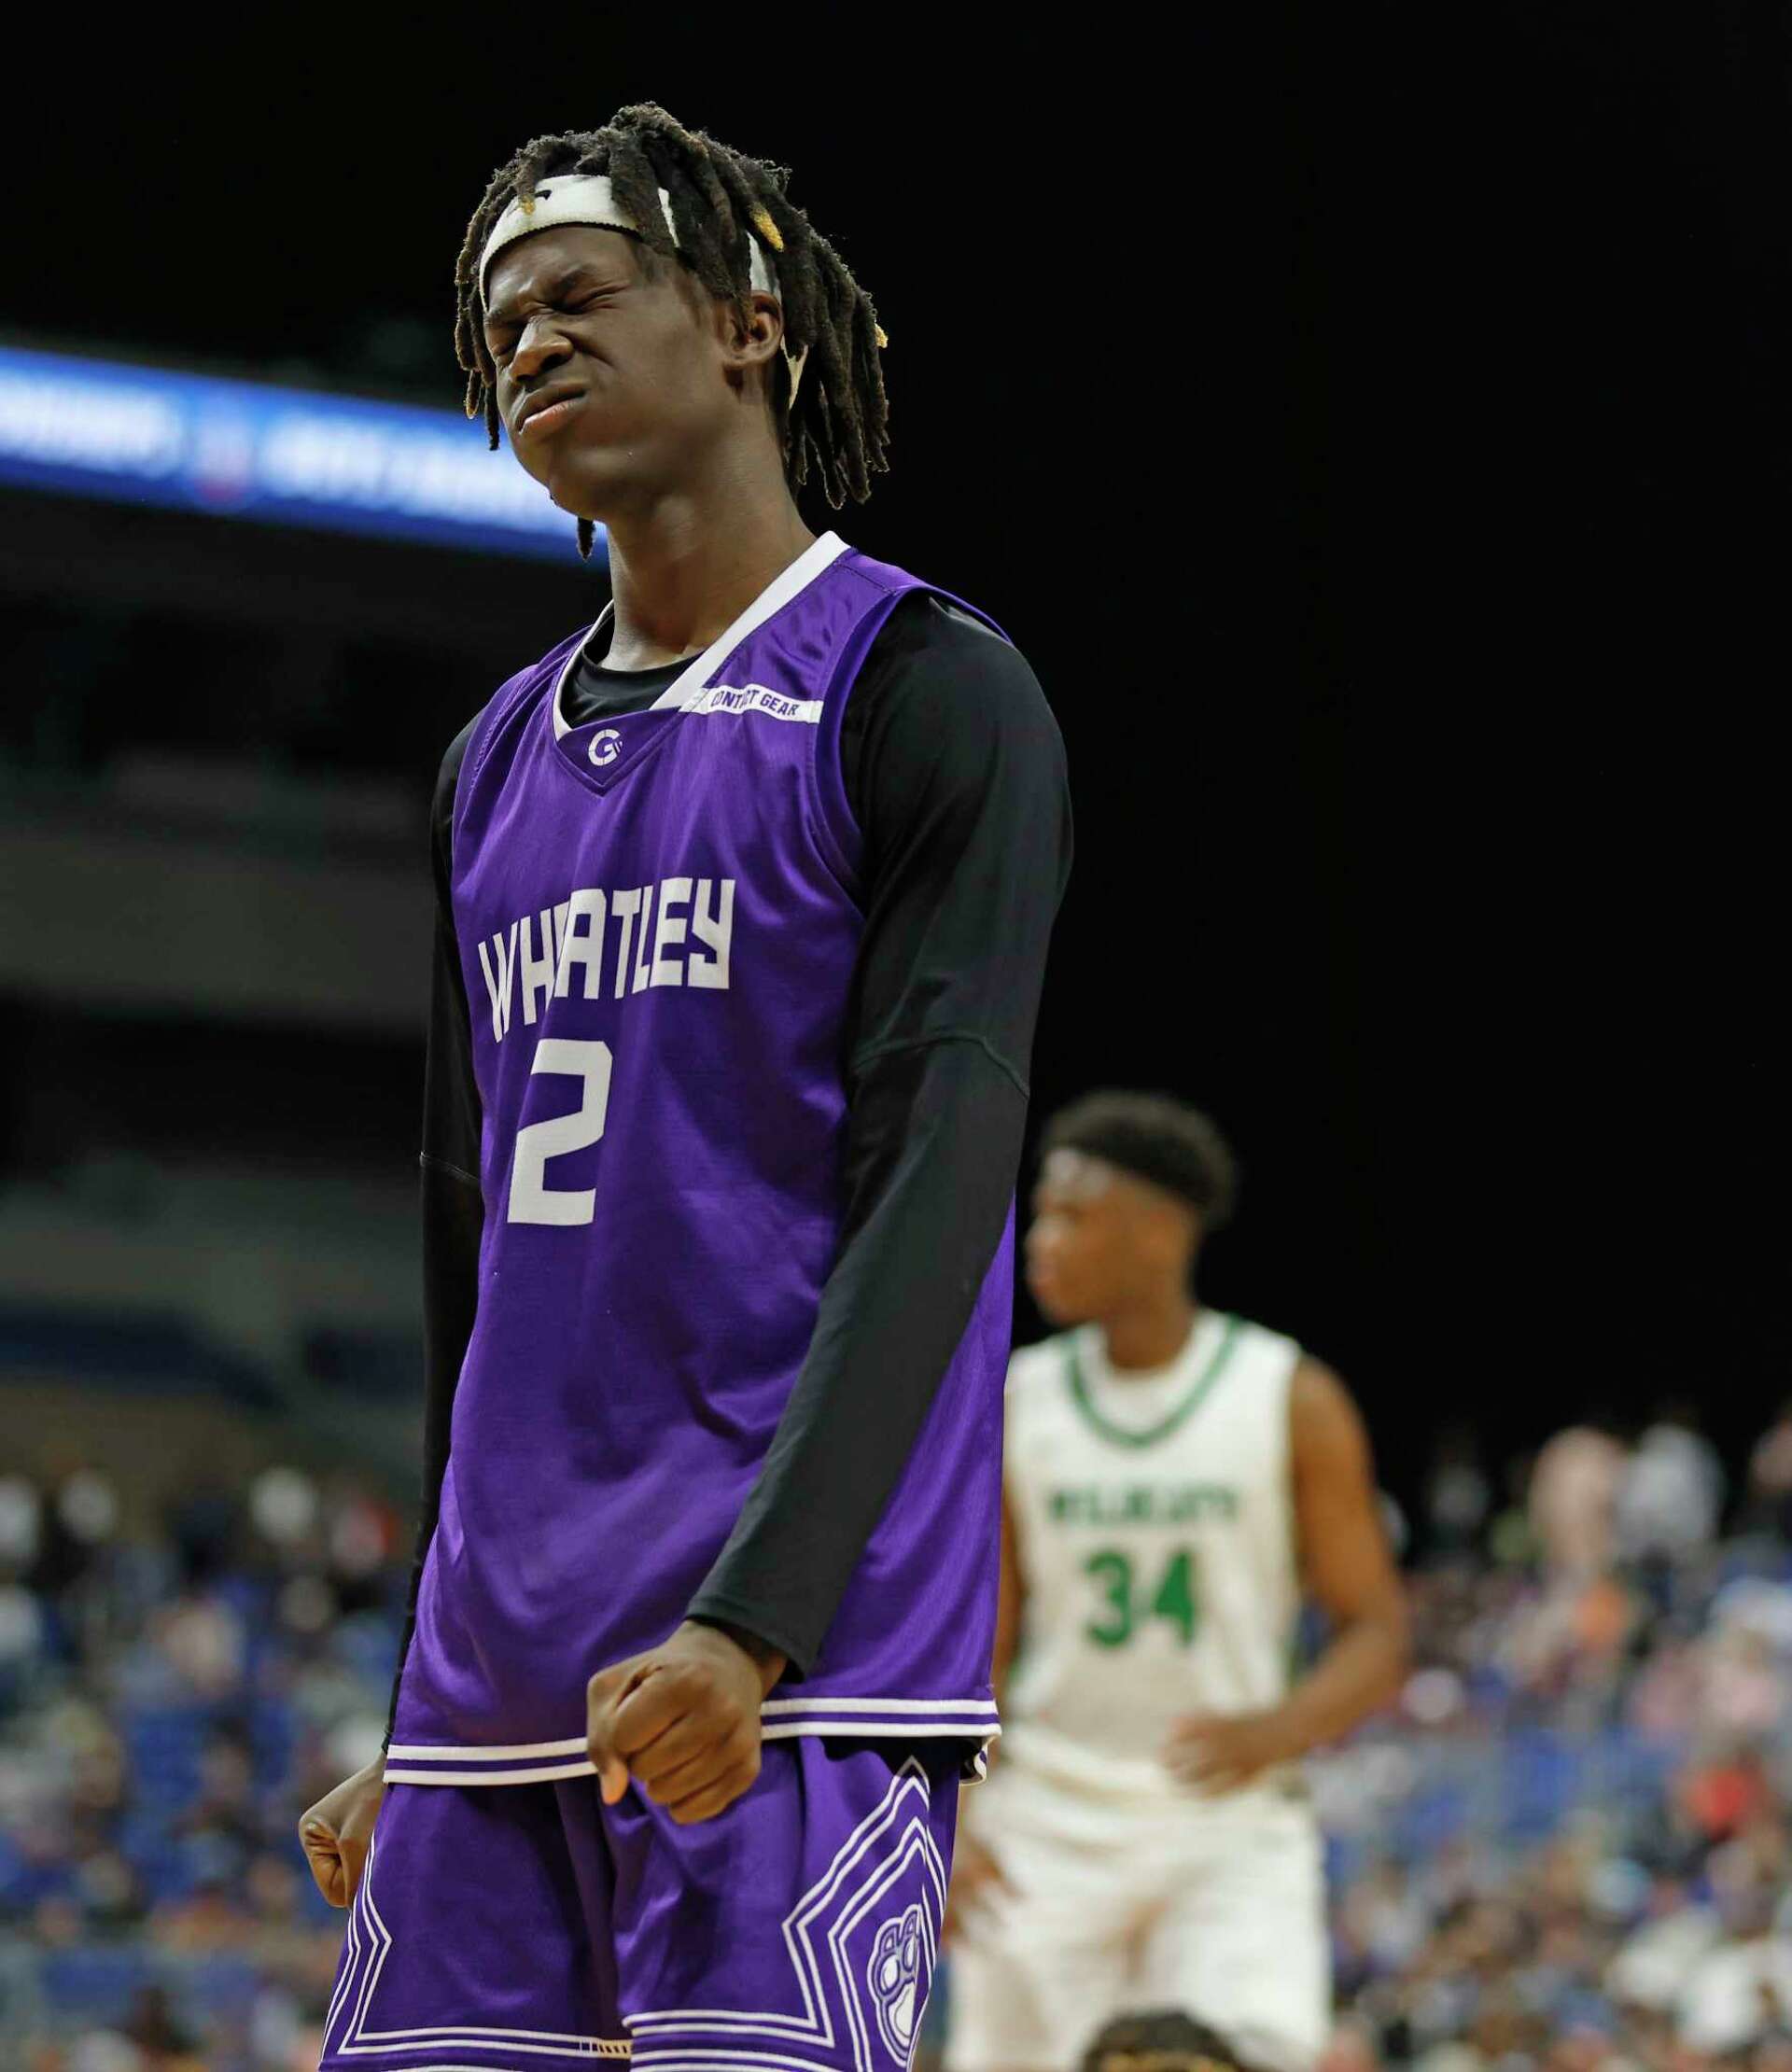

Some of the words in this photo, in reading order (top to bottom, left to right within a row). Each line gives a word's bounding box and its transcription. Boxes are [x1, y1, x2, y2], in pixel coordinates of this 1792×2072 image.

[760, 693, 800, 716] GEAR
[507, 1038, 613, 1225] 2
[1085, 1549, 1196, 1649] 34
